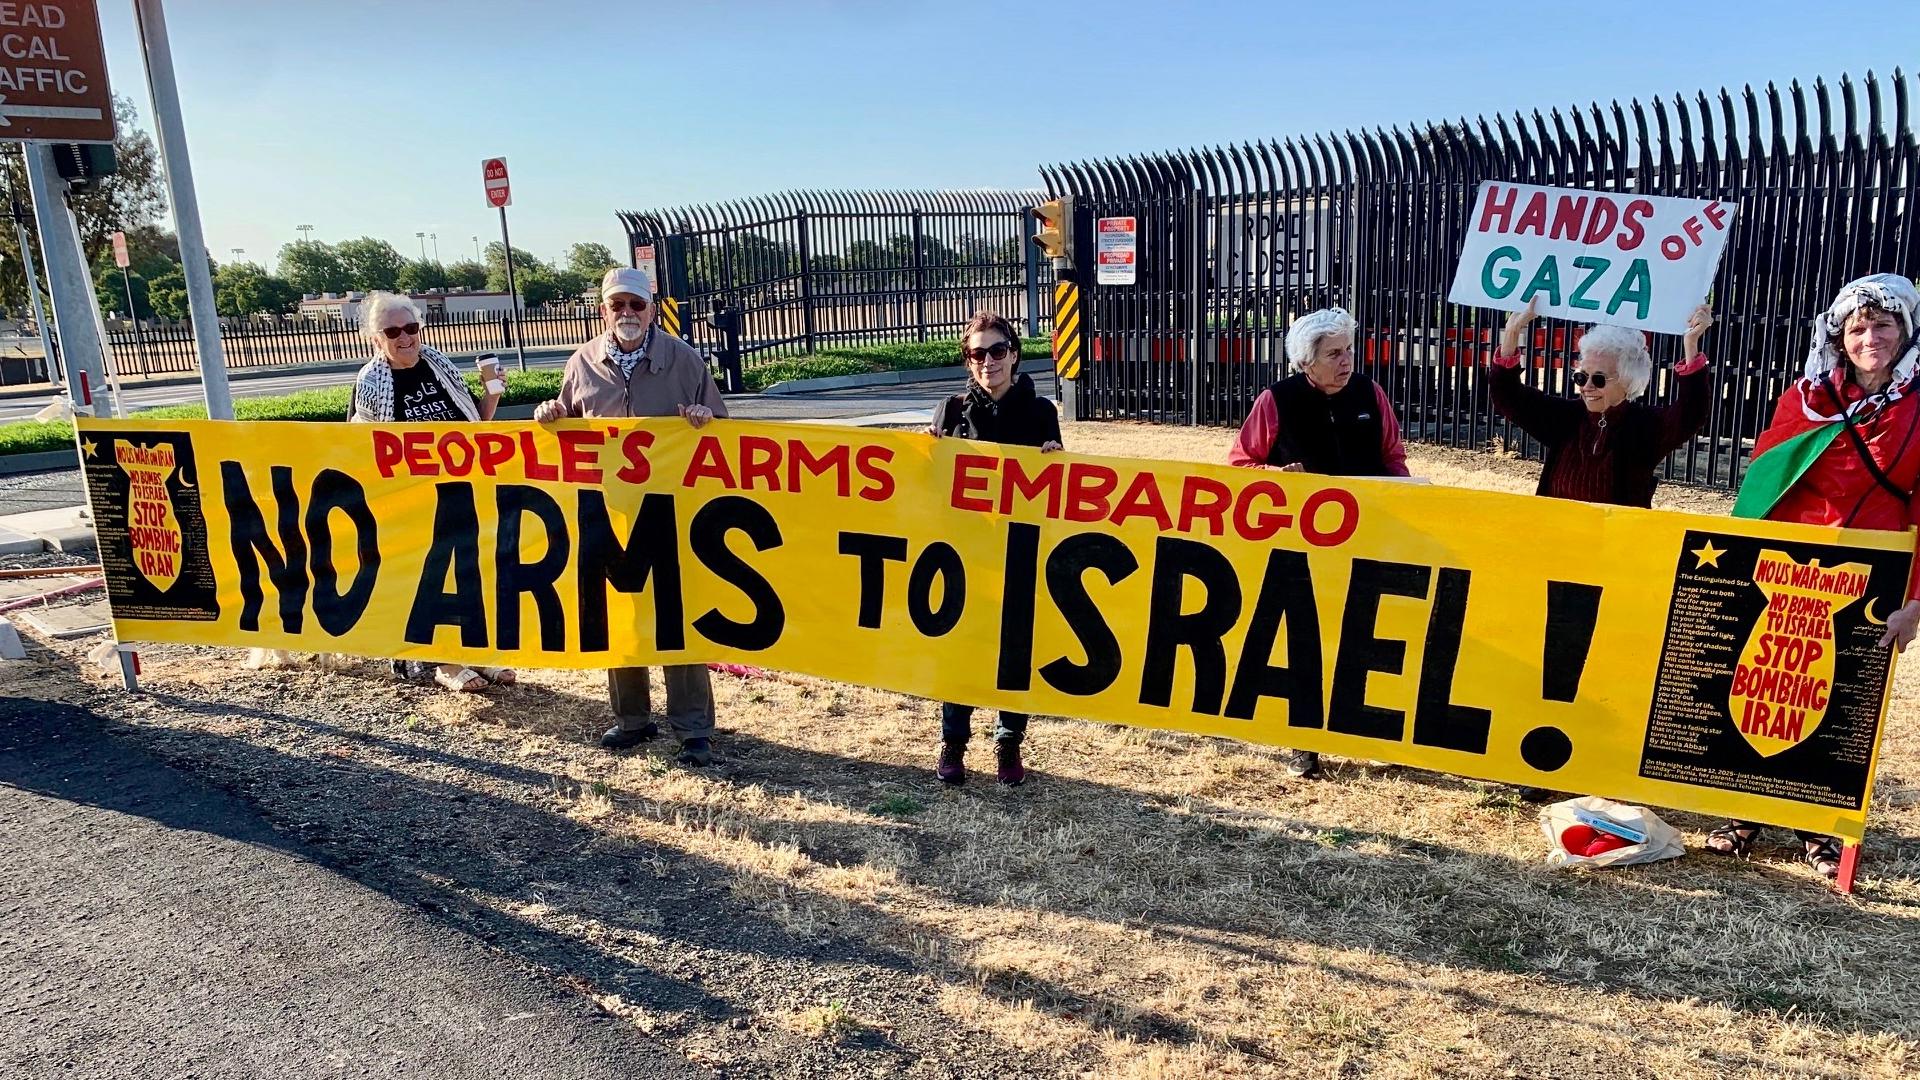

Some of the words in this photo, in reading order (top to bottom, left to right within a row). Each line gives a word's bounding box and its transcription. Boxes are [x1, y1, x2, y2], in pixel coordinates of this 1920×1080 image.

[0, 33, 70, 61] CAL
[487, 169, 494, 178] DO
[495, 168, 504, 177] NOT
[490, 190, 505, 199] ENTER
[1479, 186, 1654, 250] HANDS
[1661, 200, 1727, 261] OFF
[1481, 245, 1651, 320] GAZA
[403, 381, 438, 408] قاوم
[404, 400, 448, 418] RESIST
[134, 448, 150, 466] WAR
[157, 450, 175, 467] IRAN
[129, 470, 139, 484] NO
[140, 472, 161, 486] BOMBS
[373, 427, 655, 485] PEOPLE'S
[682, 436, 896, 501] ARMS
[951, 454, 1360, 546] EMBARGO
[132, 485, 141, 499] TO
[141, 486, 168, 501] ISRAEL
[134, 501, 167, 527] STOP
[129, 527, 180, 554] BOMBING
[141, 551, 175, 577] IRAN
[220, 460, 381, 637] NO
[404, 482, 785, 652] ARMS
[838, 531, 965, 637] TO
[1755, 559, 1775, 582] NO
[1774, 563, 1790, 585] US
[1790, 564, 1819, 589] WAR
[1833, 571, 1866, 596] IRAN
[1685, 610, 1701, 618] stars
[1768, 592, 1788, 612] NO
[1787, 595, 1831, 618] BOMBS
[1766, 610, 1783, 632] TO
[1783, 613, 1831, 639] ISRAEL
[1754, 633, 1822, 673] STOP
[1671, 686, 1689, 694] begin
[1732, 665, 1826, 710] BOMBING
[1668, 704, 1699, 713] thousand
[1741, 700, 1805, 740] IRAN
